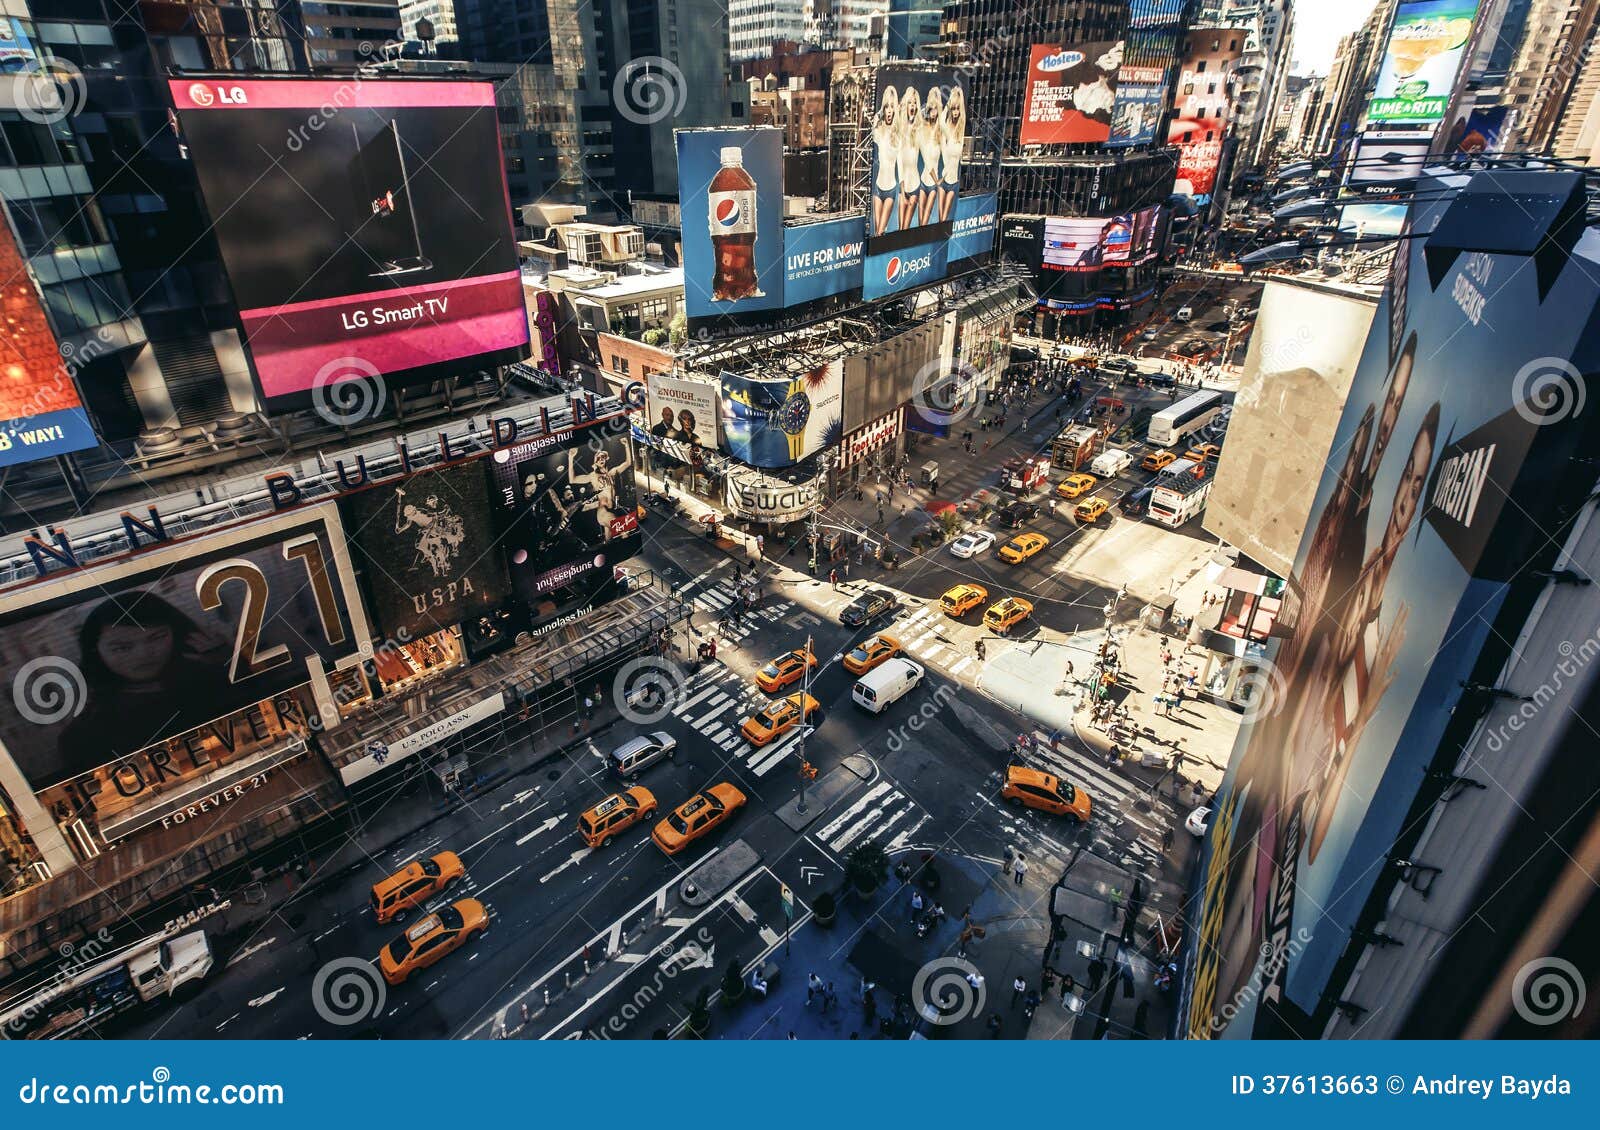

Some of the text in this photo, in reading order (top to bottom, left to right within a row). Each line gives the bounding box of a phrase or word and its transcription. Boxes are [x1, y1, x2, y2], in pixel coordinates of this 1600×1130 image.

[1042, 52, 1081, 69] Hostess
[219, 86, 248, 105] LG
[1032, 86, 1073, 94] SWEETEST
[1029, 114, 1040, 122] OF
[1030, 107, 1064, 115] HISTORY
[788, 253, 810, 270] LIVE
[813, 248, 833, 264] FOR
[902, 253, 931, 277] pepsi
[341, 297, 449, 331] LG Smart TV
[511, 430, 575, 458] sunglass hut
[851, 422, 897, 455] Foot Locker
[503, 486, 514, 505] hut
[1432, 444, 1496, 528] VIRGIN
[611, 516, 636, 533] Ray-Ban
[536, 561, 593, 592] sunglass hut
[196, 532, 344, 685] 21
[413, 577, 474, 614] USPA
[532, 604, 594, 637] sunglass hut
[401, 712, 471, 749] U.S. POLO ASSN.
[77, 697, 300, 813] FOREVER
[161, 774, 270, 830] FOREVER 21
